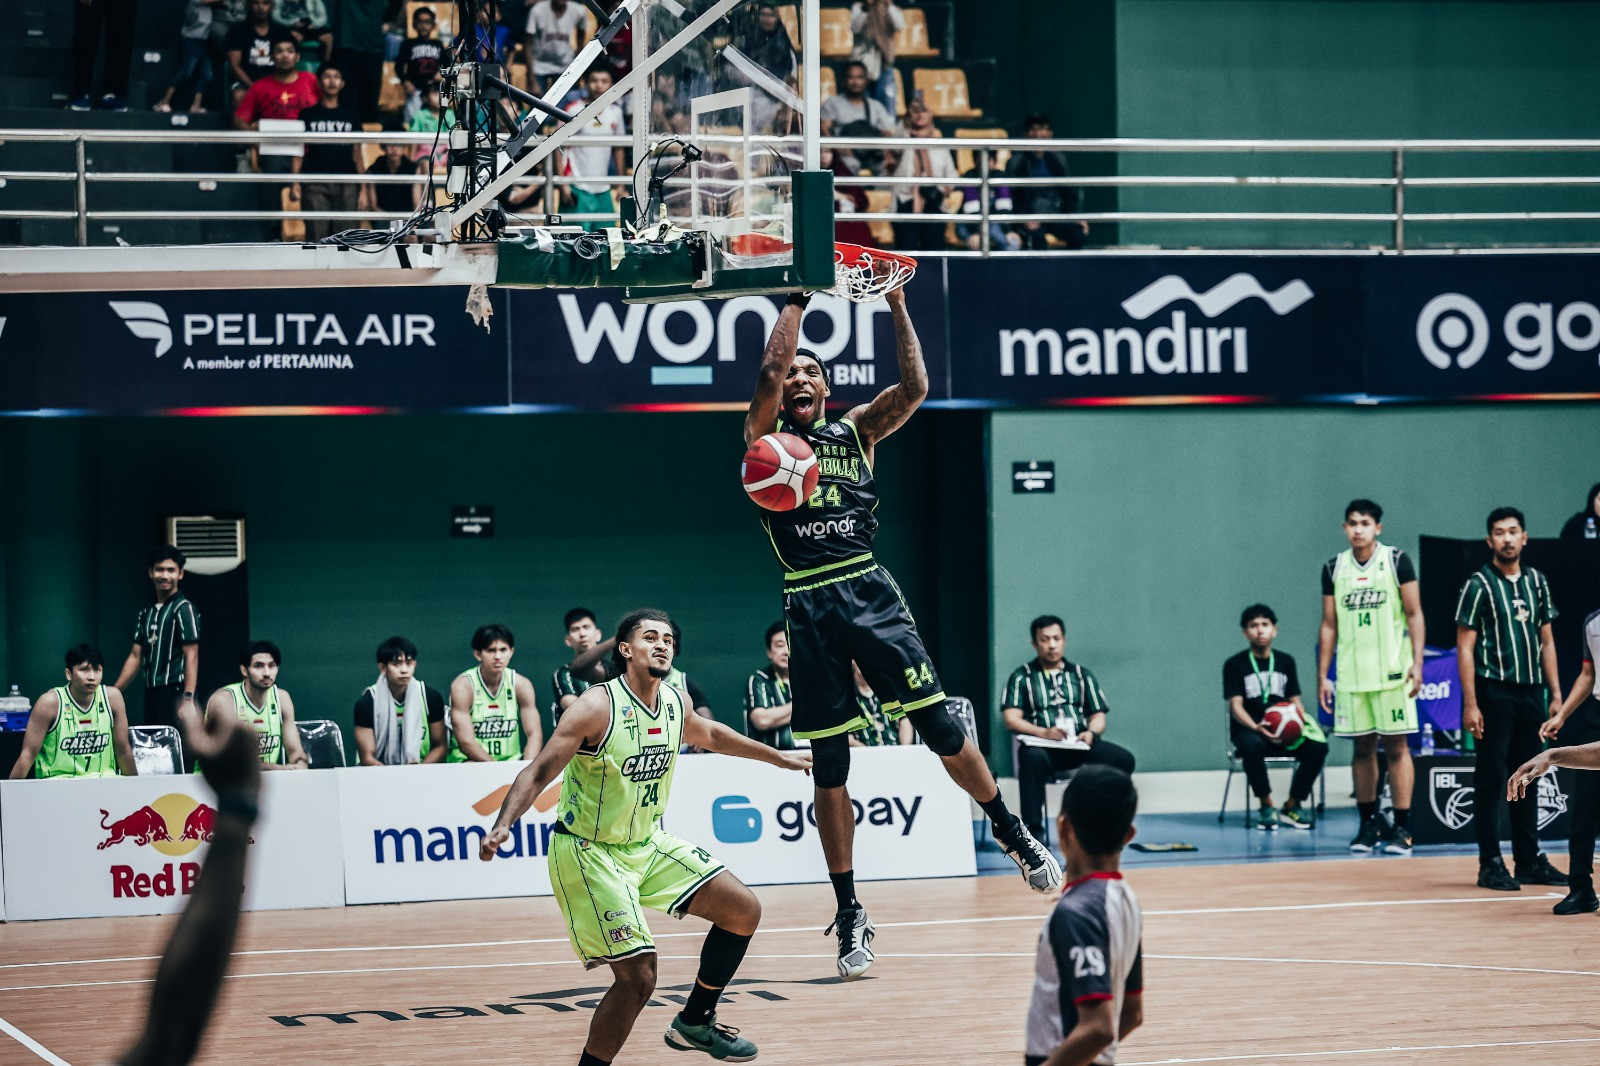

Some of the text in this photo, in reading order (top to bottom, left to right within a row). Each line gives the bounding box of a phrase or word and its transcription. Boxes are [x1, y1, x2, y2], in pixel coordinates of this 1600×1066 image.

[183, 313, 436, 347] PELITA AIR
[1503, 301, 1600, 371] go
[1000, 311, 1249, 376] mandiri
[183, 354, 354, 370] A member of PERTAMINA
[808, 483, 843, 509] 24
[795, 515, 857, 538] wondr
[1358, 612, 1372, 627] 14
[904, 661, 935, 691] 24
[61, 733, 109, 750] CAESAR
[488, 740, 501, 756] 18
[84, 756, 92, 772] 7
[1435, 773, 1462, 789] IBL
[641, 782, 659, 807] 24
[373, 817, 556, 864] mandir
[110, 862, 176, 898] Red
[1069, 945, 1106, 978] 29
